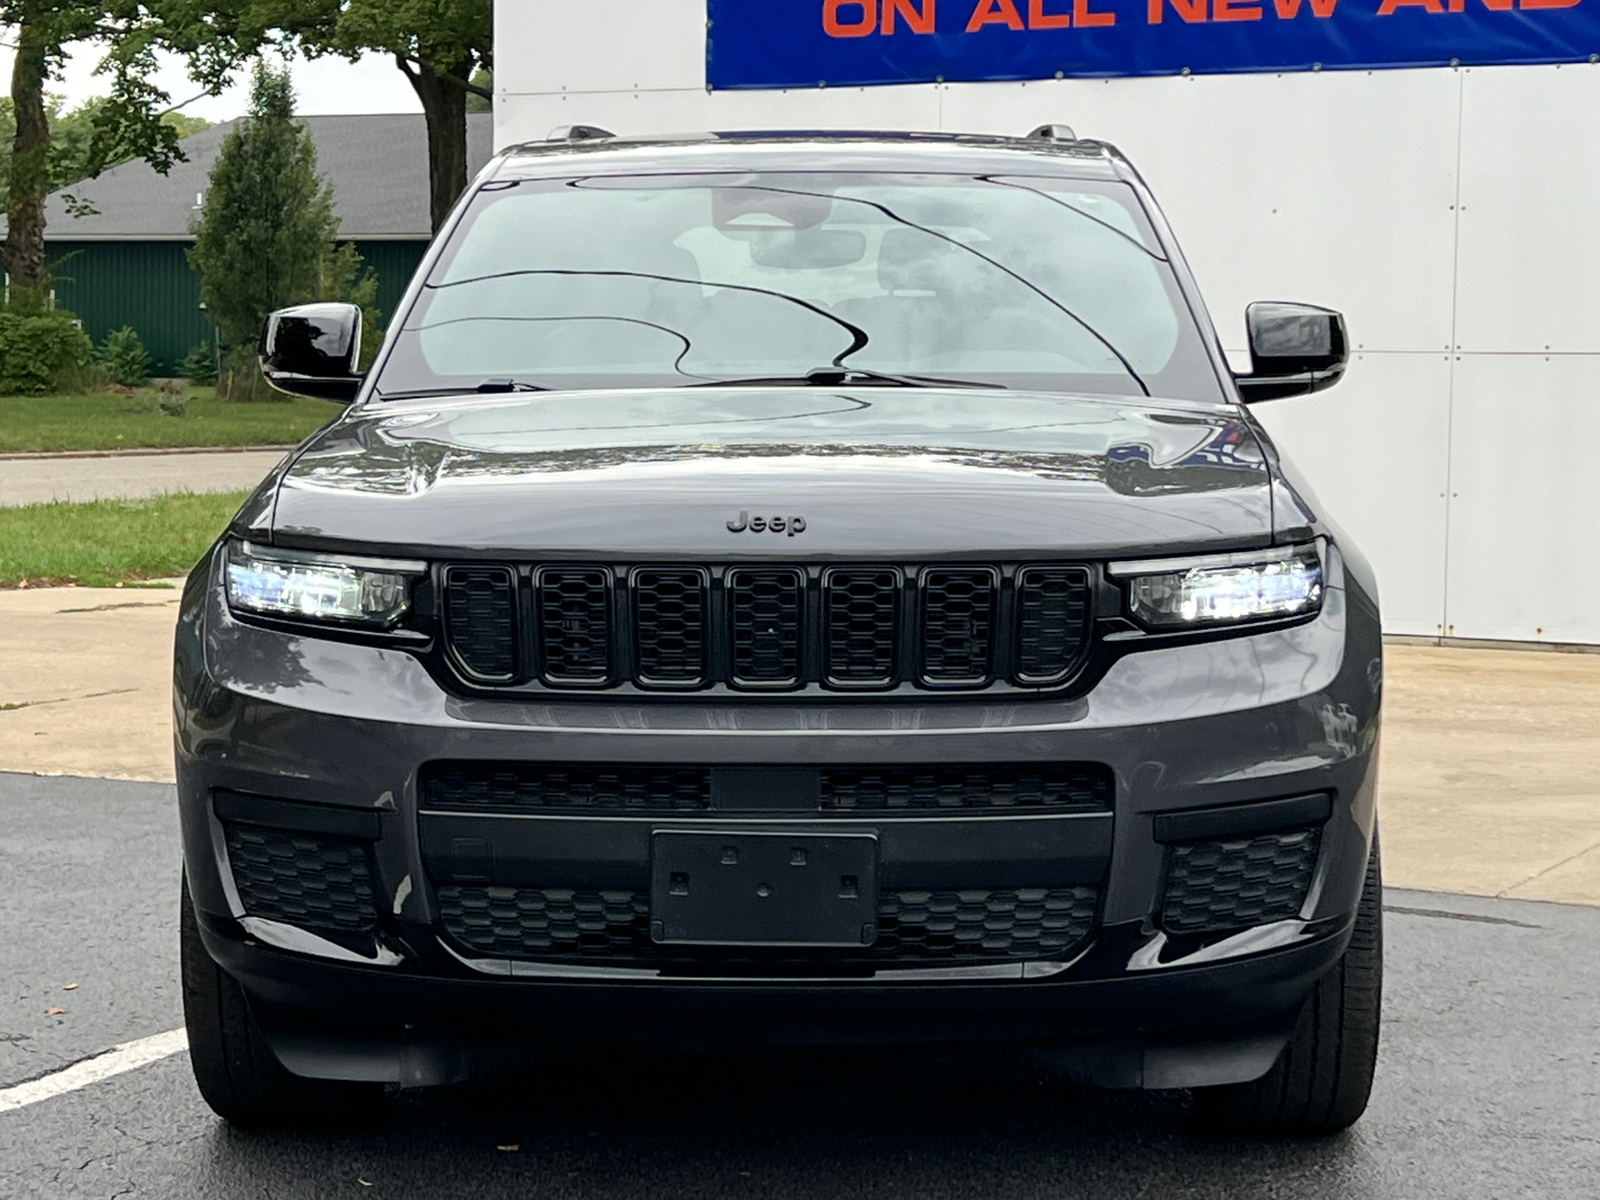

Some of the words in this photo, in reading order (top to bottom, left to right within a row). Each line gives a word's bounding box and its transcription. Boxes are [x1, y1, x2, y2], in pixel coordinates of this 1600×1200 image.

[822, 0, 936, 38] ON
[964, 0, 1116, 33] ALL
[726, 510, 807, 537] Jeep
